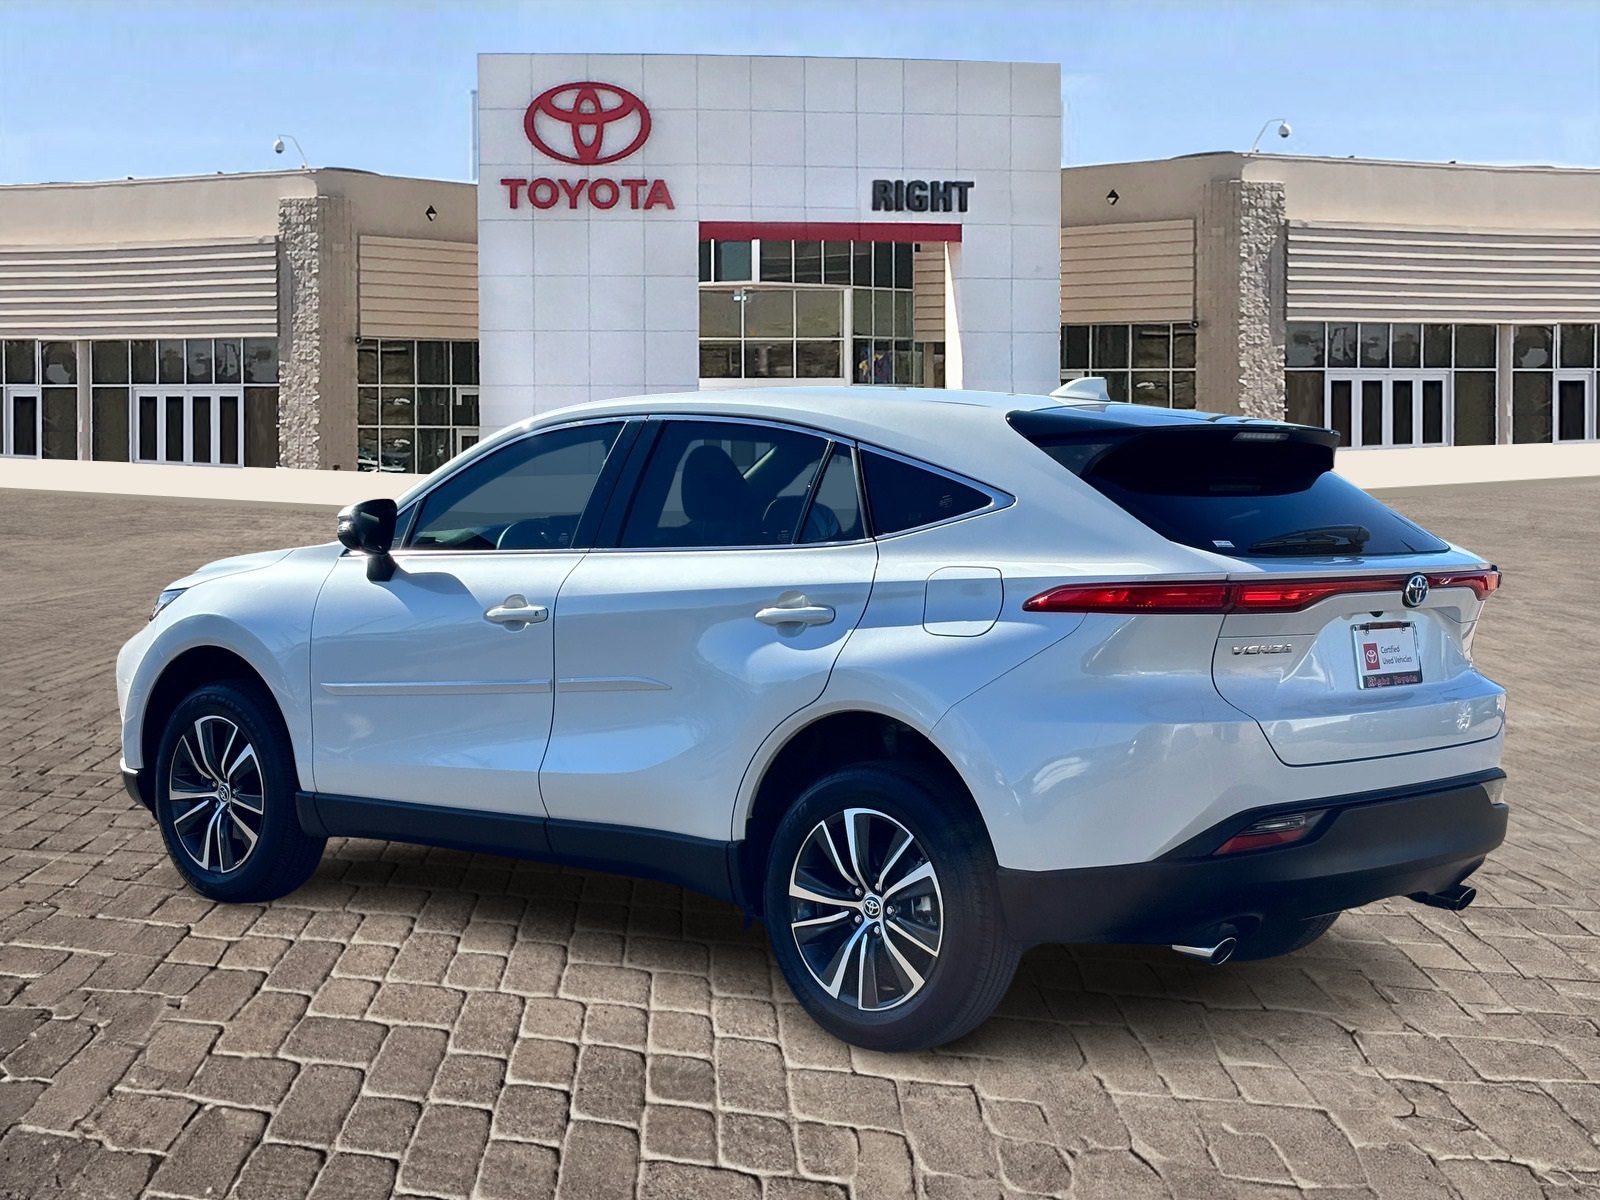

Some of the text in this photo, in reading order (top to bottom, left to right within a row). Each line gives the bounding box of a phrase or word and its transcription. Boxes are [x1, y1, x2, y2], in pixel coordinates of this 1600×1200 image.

[500, 177, 675, 210] TOYOTA
[872, 179, 975, 212] RIGHT
[1232, 644, 1292, 655] VENZA
[1380, 645, 1400, 654] Certified
[1382, 655, 1413, 665] Used Vehicles
